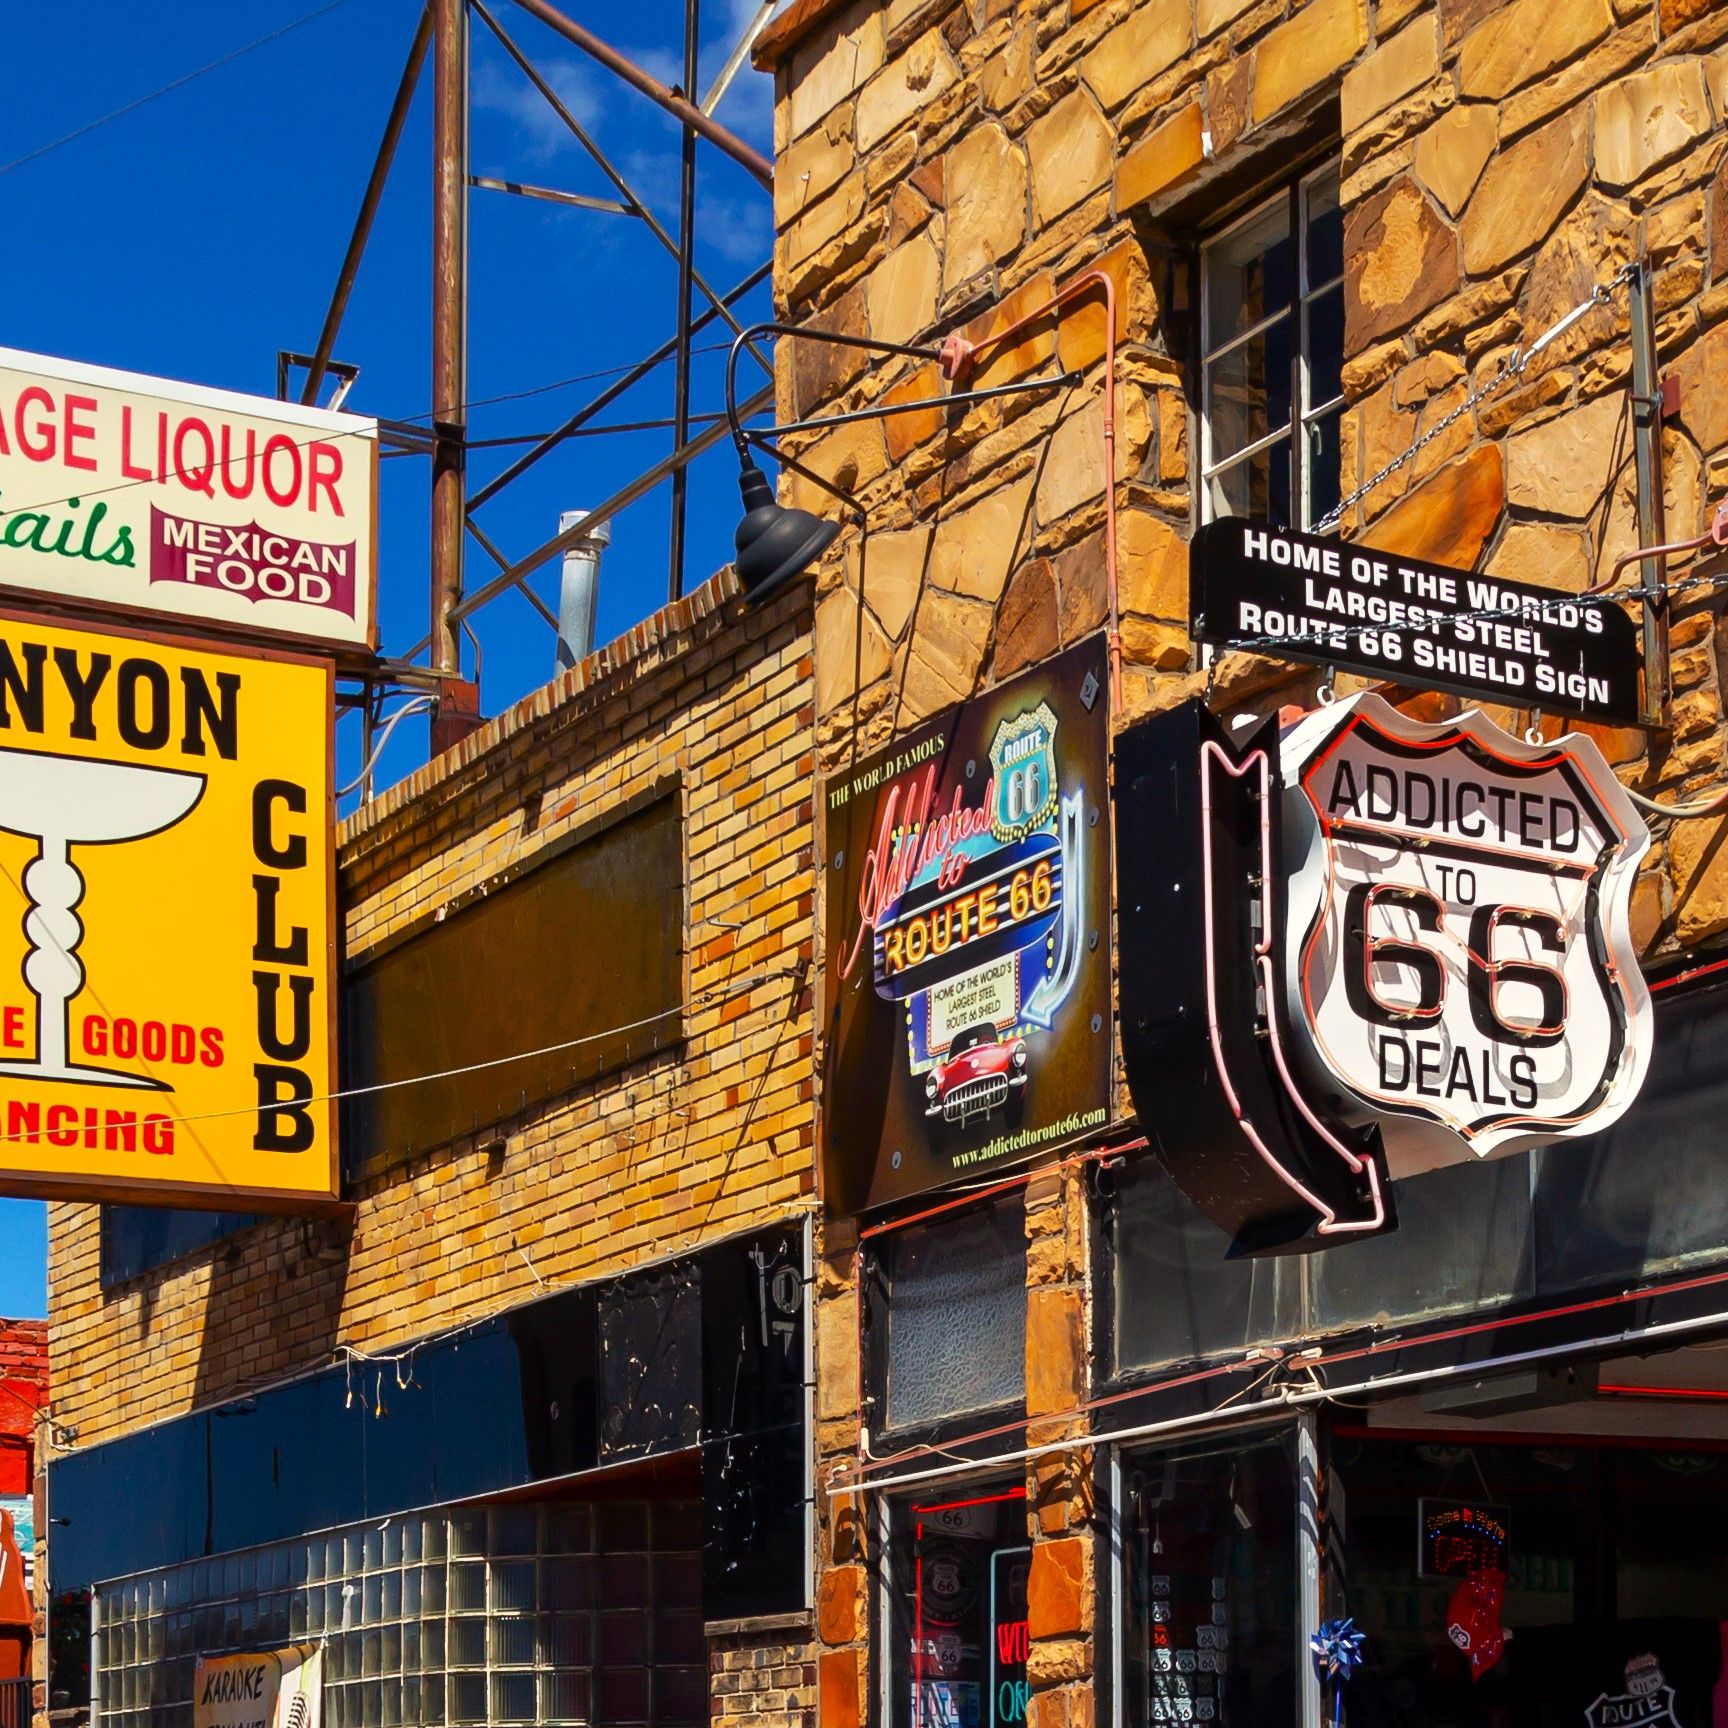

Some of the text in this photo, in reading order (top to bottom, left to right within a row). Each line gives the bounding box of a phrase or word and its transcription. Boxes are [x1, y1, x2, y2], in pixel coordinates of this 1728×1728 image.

[120, 407, 346, 518] LIQUOR
[162, 517, 348, 578] MEXICAN
[185, 552, 334, 604] FOOD
[1242, 529, 1604, 635] HOME OF THE WORLD'S
[1304, 579, 1551, 659] LARGEST STEEL
[1238, 601, 1610, 705] ROUTE 66 SHIELD SIGN
[828, 732, 946, 810] THE WORLD FAMOUS
[1003, 728, 1043, 765] ROUTE
[1007, 759, 1041, 824] 66
[1326, 759, 1582, 854] ADDICTED
[838, 764, 996, 980] Addicted
[937, 845, 973, 892] to
[1435, 865, 1478, 907] TO
[884, 860, 1053, 973] ROUTE 66
[251, 777, 316, 1155] CLUB
[933, 983, 955, 1003] HOME
[1343, 879, 1571, 1050] 66
[945, 1012, 967, 1031] ROUTE
[948, 985, 997, 1014] LARGEST STEEL
[82, 1012, 226, 1069] GOODS
[1378, 1034, 1538, 1111] DEALS
[951, 1108, 1107, 1171] www.addictedtoroute66.com
[201, 1664, 267, 1706] KARAOKE
